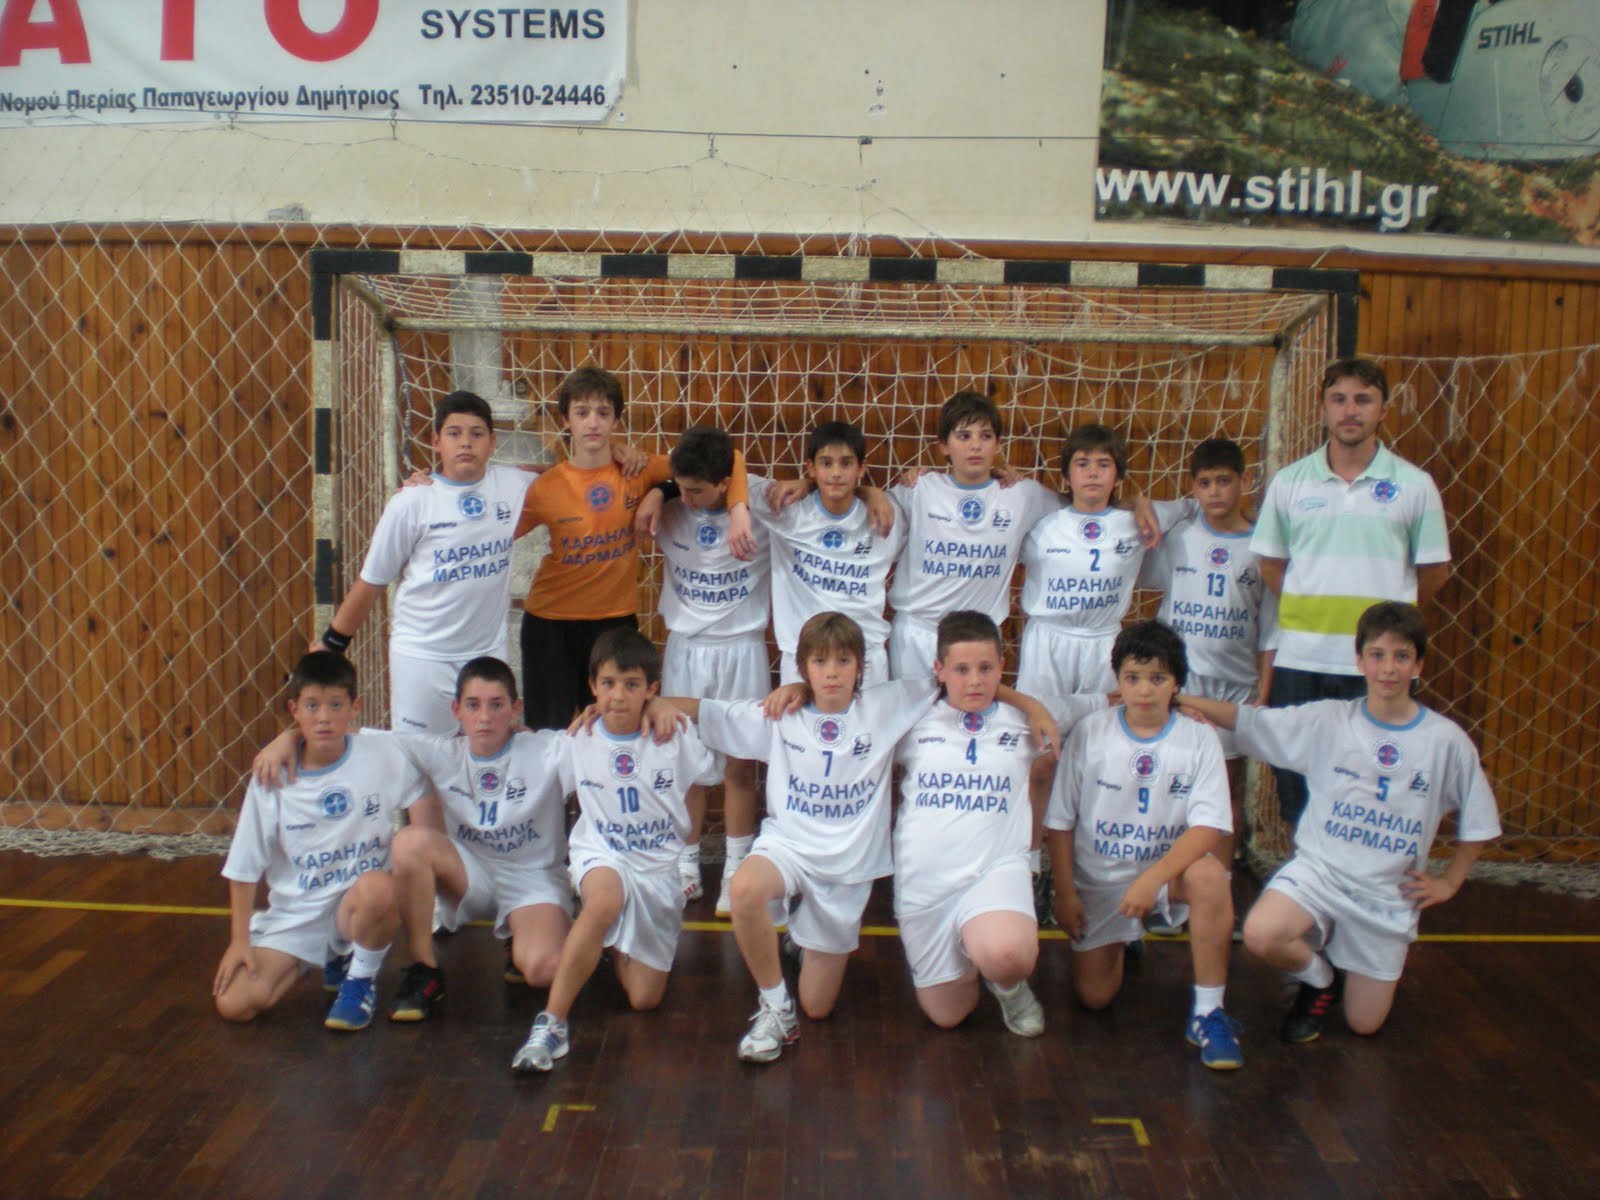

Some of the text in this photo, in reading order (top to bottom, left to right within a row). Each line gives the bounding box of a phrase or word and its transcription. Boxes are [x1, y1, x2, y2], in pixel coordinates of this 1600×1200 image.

[420, 8, 605, 39] SYSTEMS
[1477, 21, 1542, 49] STIHL
[0, 83, 606, 114] Νομού Πιερίας Παπαγεωργίου Δημήτριος Τηλ. 23510-24446
[1096, 167, 1439, 228] www.stihl.gr
[924, 540, 1007, 558] ΚΑΡΑΗΛΙΑ
[1089, 549, 1101, 571] 2
[432, 557, 510, 582] ΜΑΡΜΑΡ
[793, 548, 870, 578] ΚΑΡΑΗΛΙΑ
[922, 560, 1001, 578] ΜΑΡΜΑΡΑ
[792, 564, 867, 596] ΜΑΡΜΑΡΑ
[1047, 576, 1123, 592] ΚΑΡΑΗΛΙΑ
[1207, 572, 1226, 597] 13
[1046, 593, 1120, 610] ΜΑΡΜΑΡΑ
[1173, 600, 1249, 621] ΚΑΡΑΗΛΙΑ
[822, 751, 834, 777] 7
[966, 738, 978, 765] 4
[789, 774, 875, 801] ΚΑΡΑΗΛΙΑ
[918, 772, 1012, 793] ΚΑΡΑΗΛΙΑ
[1375, 776, 1391, 801] 5
[616, 786, 640, 813] 10
[915, 792, 1009, 814] ΜΑΡΜΑΡΑ
[1138, 787, 1150, 814] 9
[479, 800, 497, 826] 14
[1331, 800, 1423, 836] ΚΑΡΑΗΛΙΑ
[1325, 820, 1418, 857] ΜΑΡΜΑΡΑ
